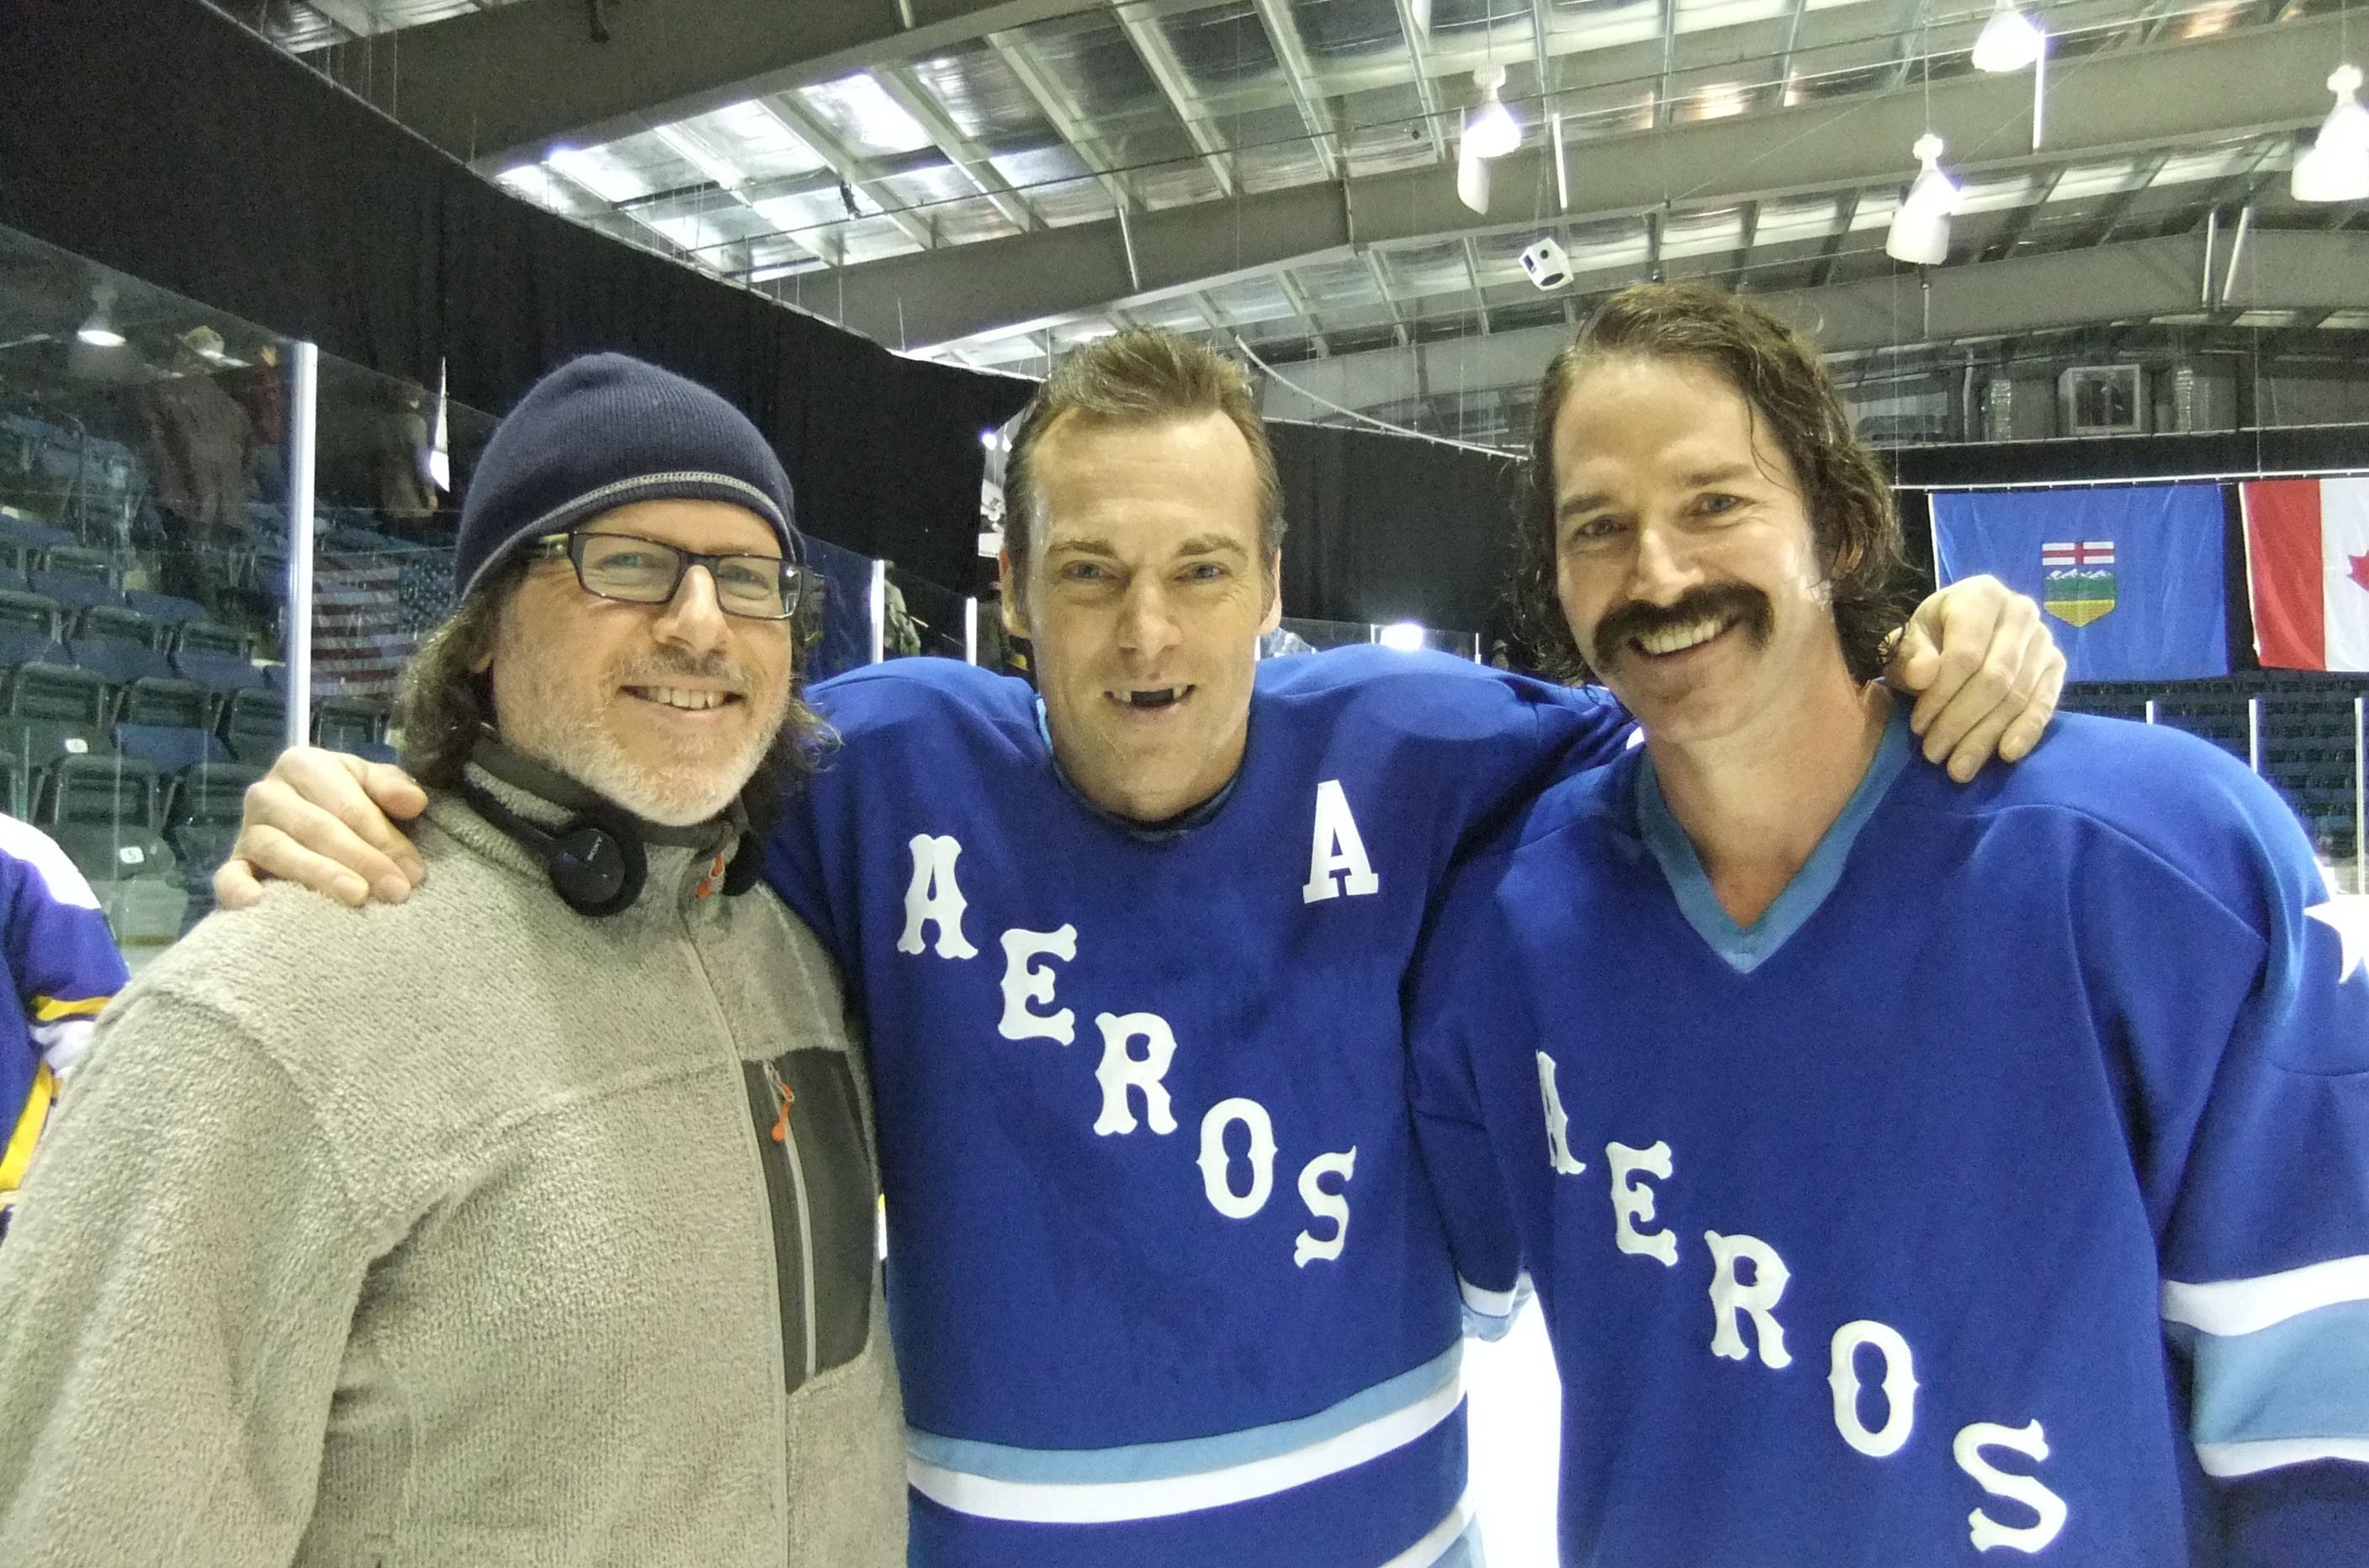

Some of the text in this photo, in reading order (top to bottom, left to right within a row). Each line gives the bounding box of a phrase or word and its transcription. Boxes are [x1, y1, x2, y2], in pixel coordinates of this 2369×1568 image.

[587, 835, 602, 861] SONY
[1302, 780, 1380, 904] A
[897, 833, 1357, 1269] AEROS
[1535, 1050, 2070, 1555] AEROS
